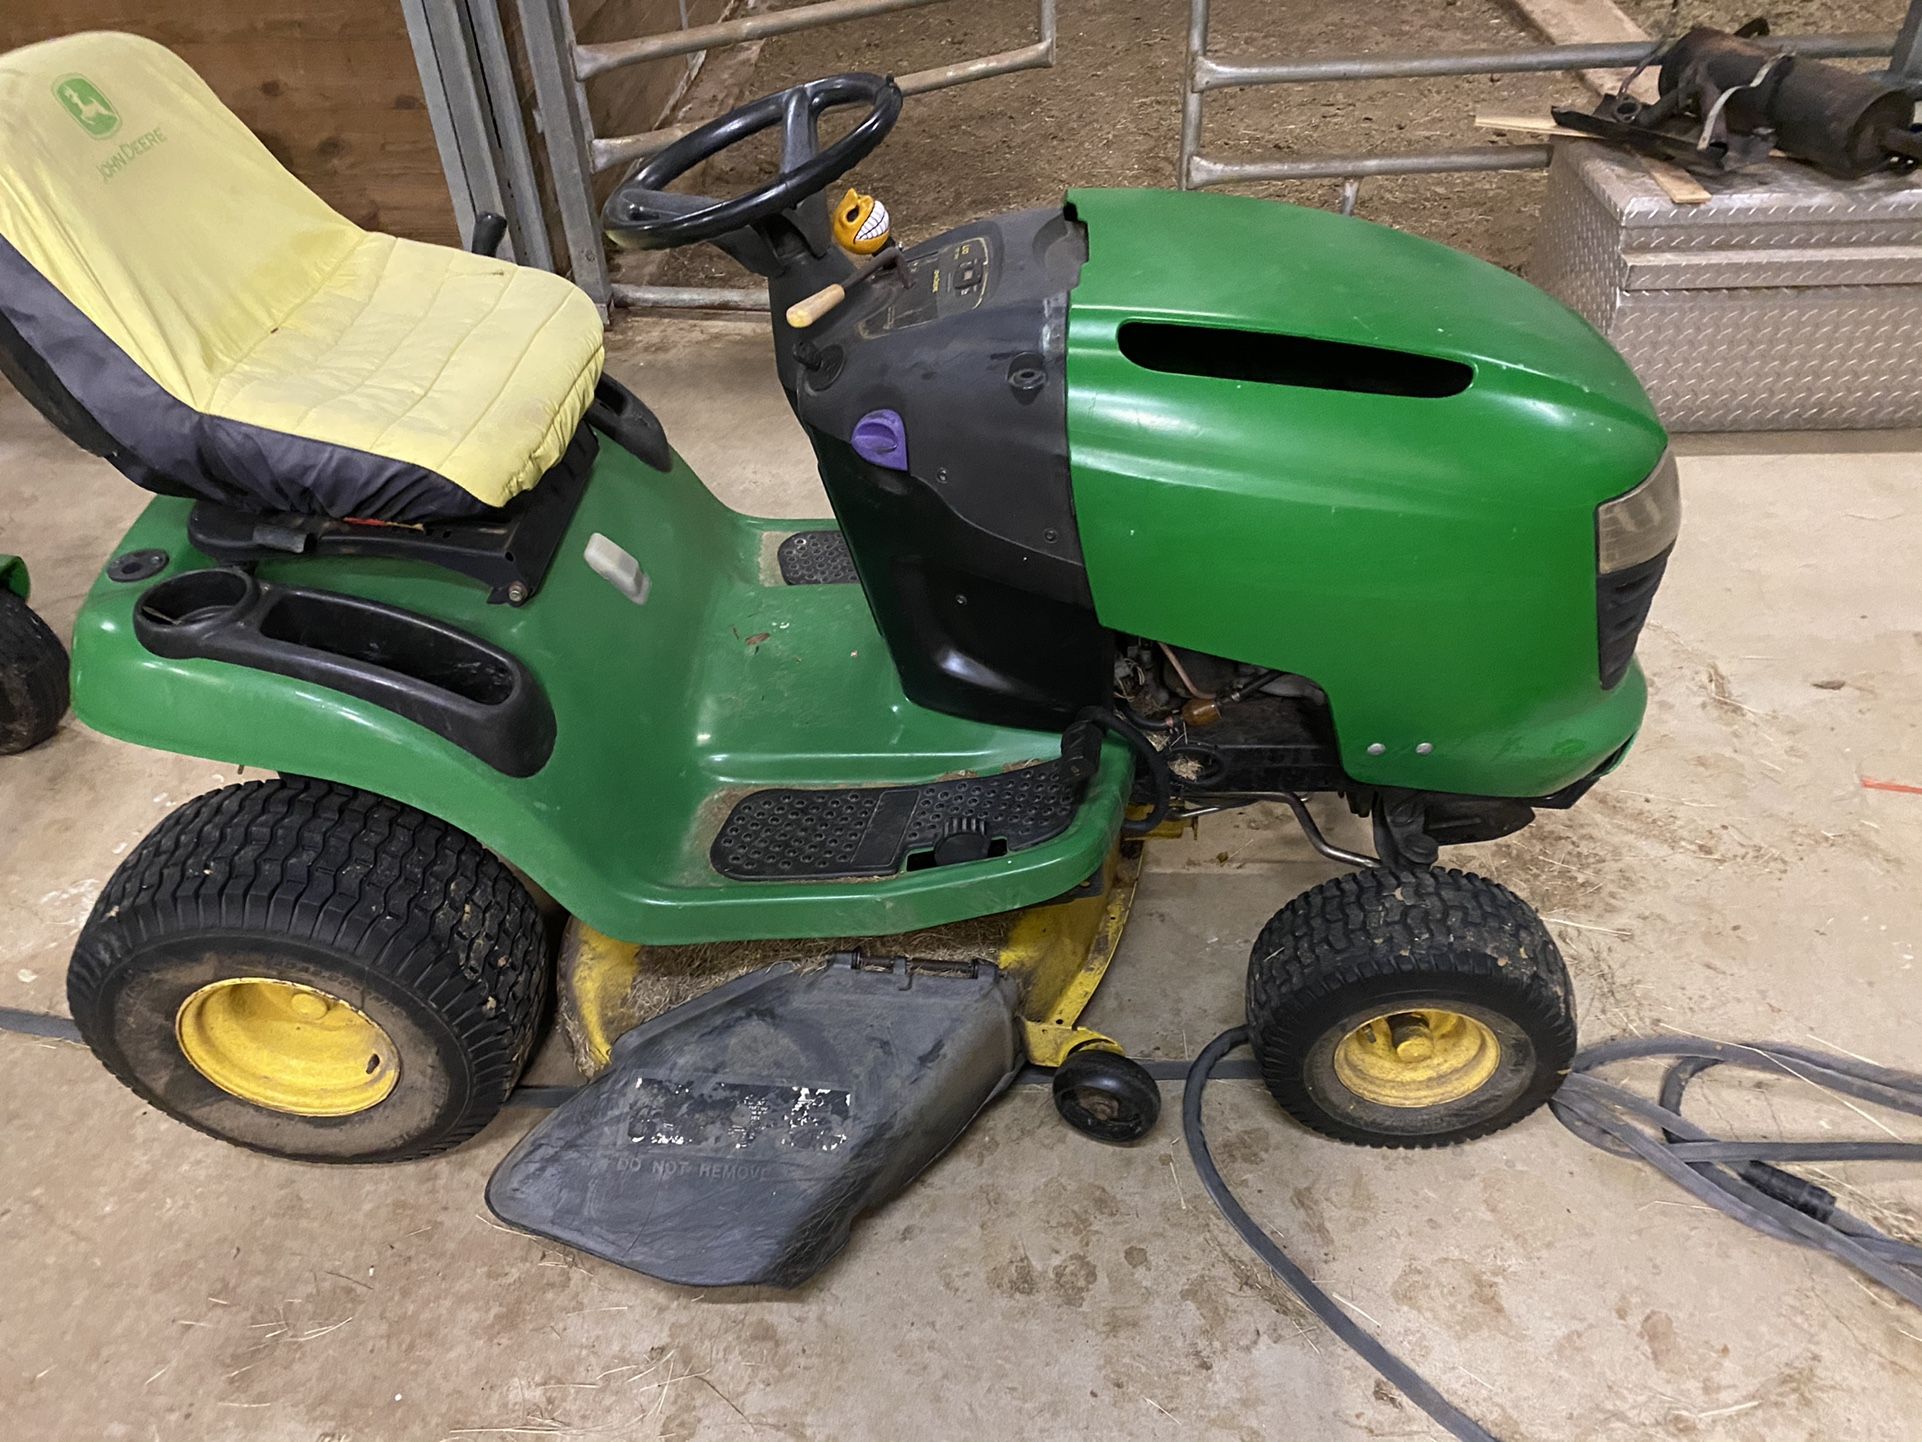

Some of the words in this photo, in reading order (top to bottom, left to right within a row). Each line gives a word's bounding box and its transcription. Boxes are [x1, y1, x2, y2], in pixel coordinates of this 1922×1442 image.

[95, 151, 128, 184] JOHN
[118, 127, 167, 161] DEERE
[616, 1157, 642, 1172] DO
[652, 1160, 690, 1177] NOT
